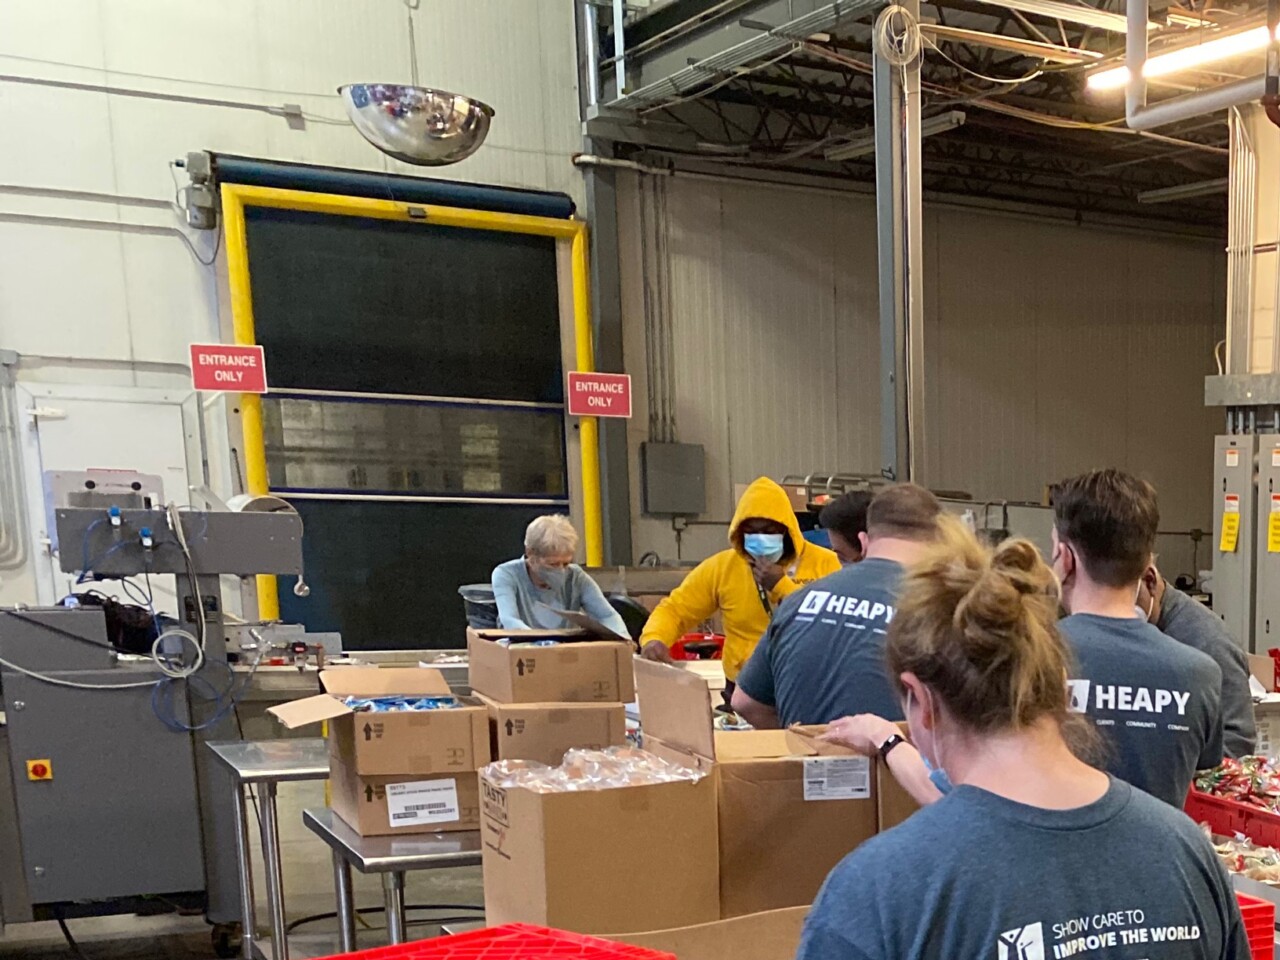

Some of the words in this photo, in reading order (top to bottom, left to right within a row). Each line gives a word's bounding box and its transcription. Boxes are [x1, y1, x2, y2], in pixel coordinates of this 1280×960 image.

[198, 353, 257, 367] ENTRANCE
[214, 370, 243, 382] ONLY
[575, 381, 624, 394] ENTRANCE
[587, 395, 612, 407] ONLY
[826, 595, 897, 624] HEAPY
[1096, 685, 1190, 715] HEAPY
[482, 782, 506, 807] TASTY
[1052, 916, 1089, 940] SHOW
[1092, 911, 1125, 929] CARE
[1125, 909, 1145, 924] TO
[1053, 931, 1117, 960] IMPROVE
[1119, 928, 1149, 945] THE
[1150, 926, 1201, 942] WORLD
